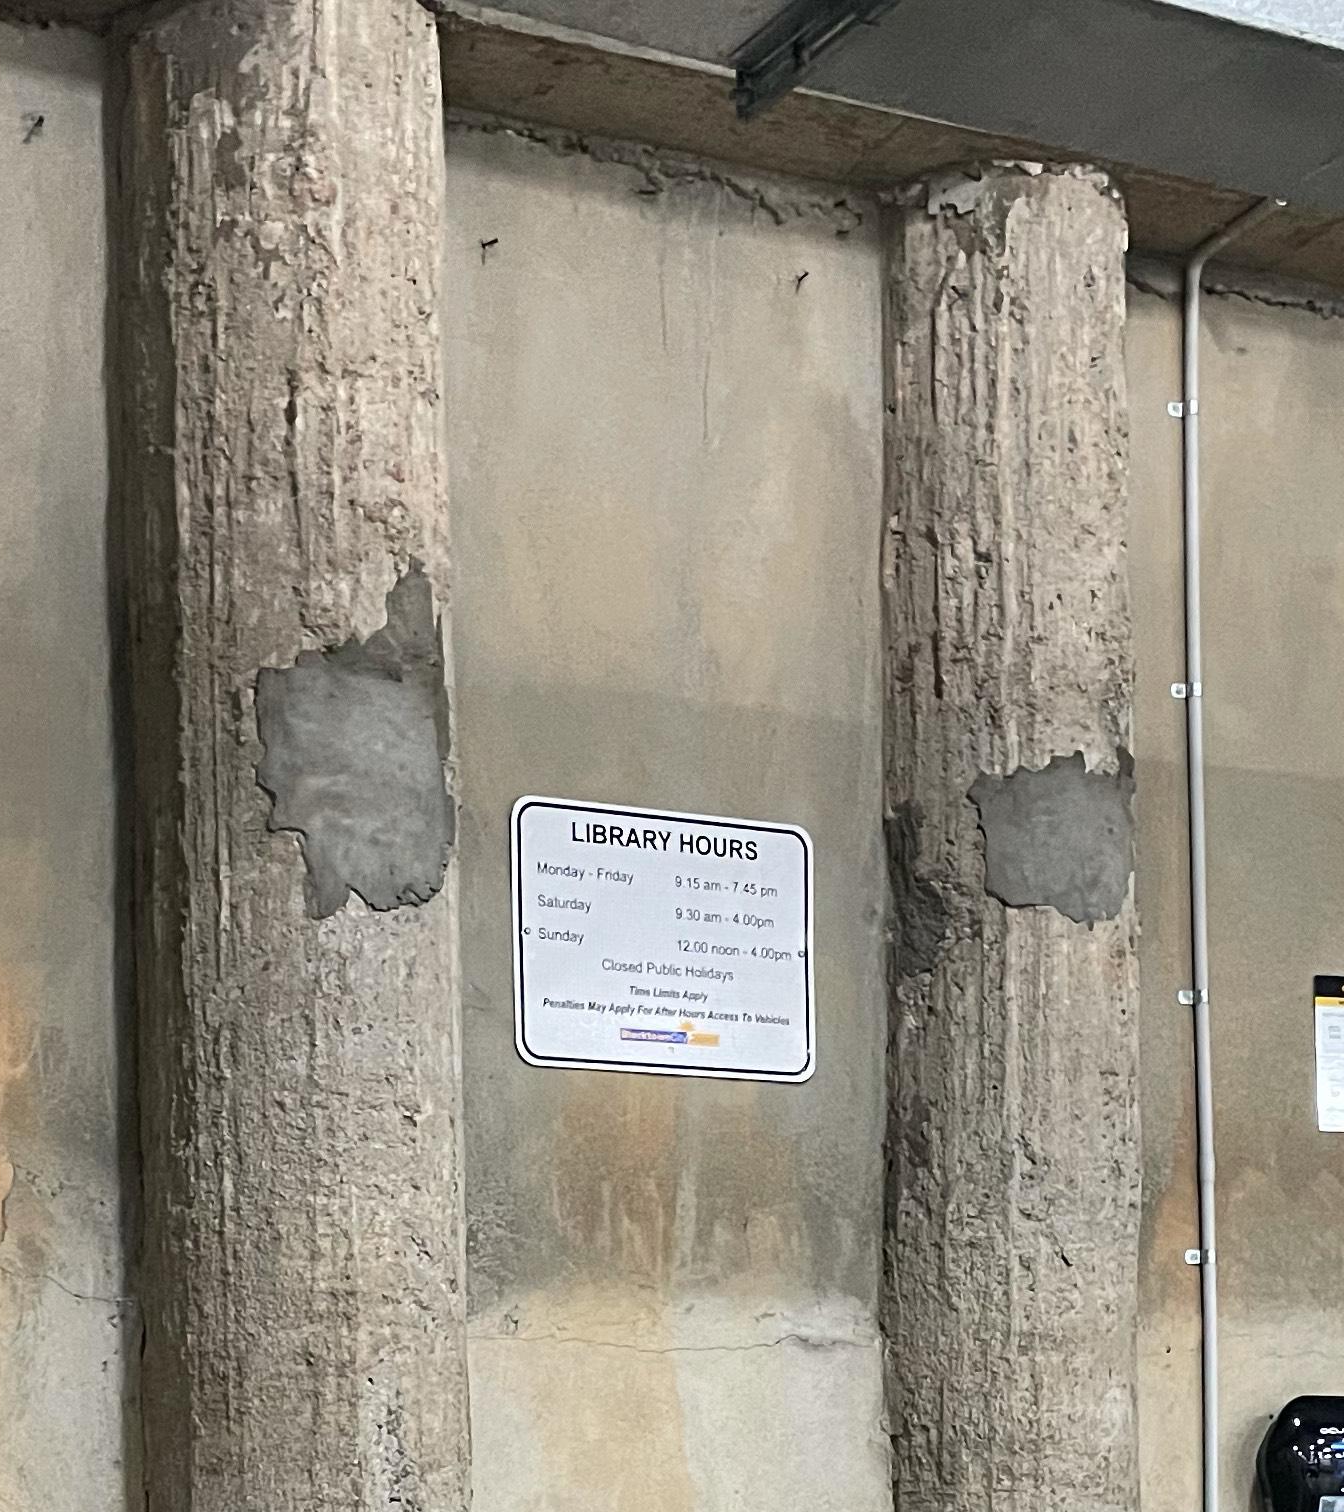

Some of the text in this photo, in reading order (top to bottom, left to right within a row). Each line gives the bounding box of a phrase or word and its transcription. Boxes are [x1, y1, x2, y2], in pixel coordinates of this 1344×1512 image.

[572, 821, 758, 860] LIBRARY HOURS
[537, 861, 585, 881] Monday
[597, 867, 634, 885] Friday
[703, 881, 721, 892] am
[760, 887, 778, 898] pm
[537, 894, 592, 914] Saturday
[703, 913, 722, 923] am
[538, 927, 584, 945] Sunday
[677, 939, 708, 954] 12.00
[711, 945, 740, 956] noon
[601, 958, 734, 984] Closed Public Holidays
[682, 989, 708, 1004] Apply
[543, 997, 585, 1010] Penalties
[587, 1001, 607, 1015] May
[608, 1002, 636, 1017] Apply
[637, 1004, 653, 1016] For
[678, 1008, 706, 1019] Hours
[707, 1010, 739, 1022] Access
[742, 1012, 753, 1023] To
